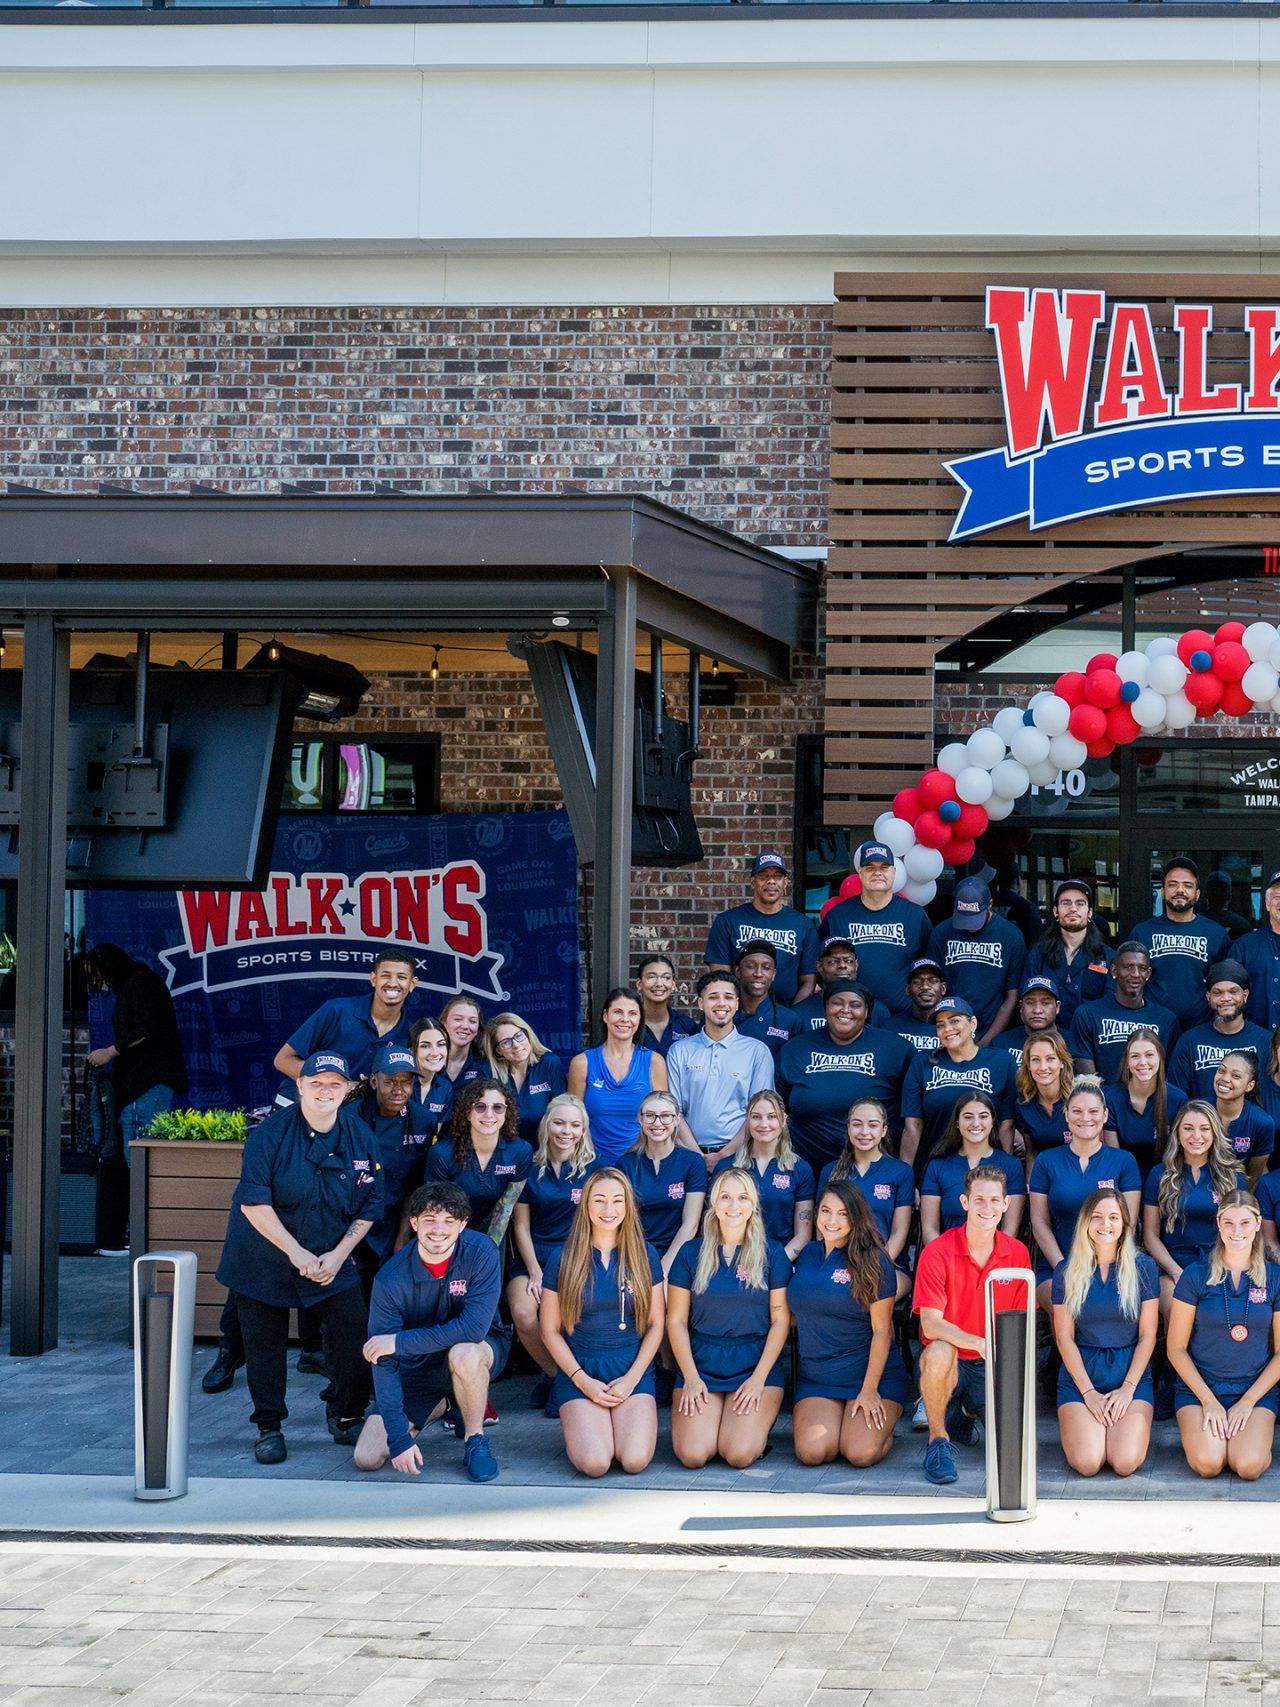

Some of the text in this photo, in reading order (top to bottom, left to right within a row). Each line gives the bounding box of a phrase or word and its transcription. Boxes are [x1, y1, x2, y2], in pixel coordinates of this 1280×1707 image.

[1084, 445, 1245, 483] SPORTS
[237, 950, 427, 970] SPORTS BISTRX
